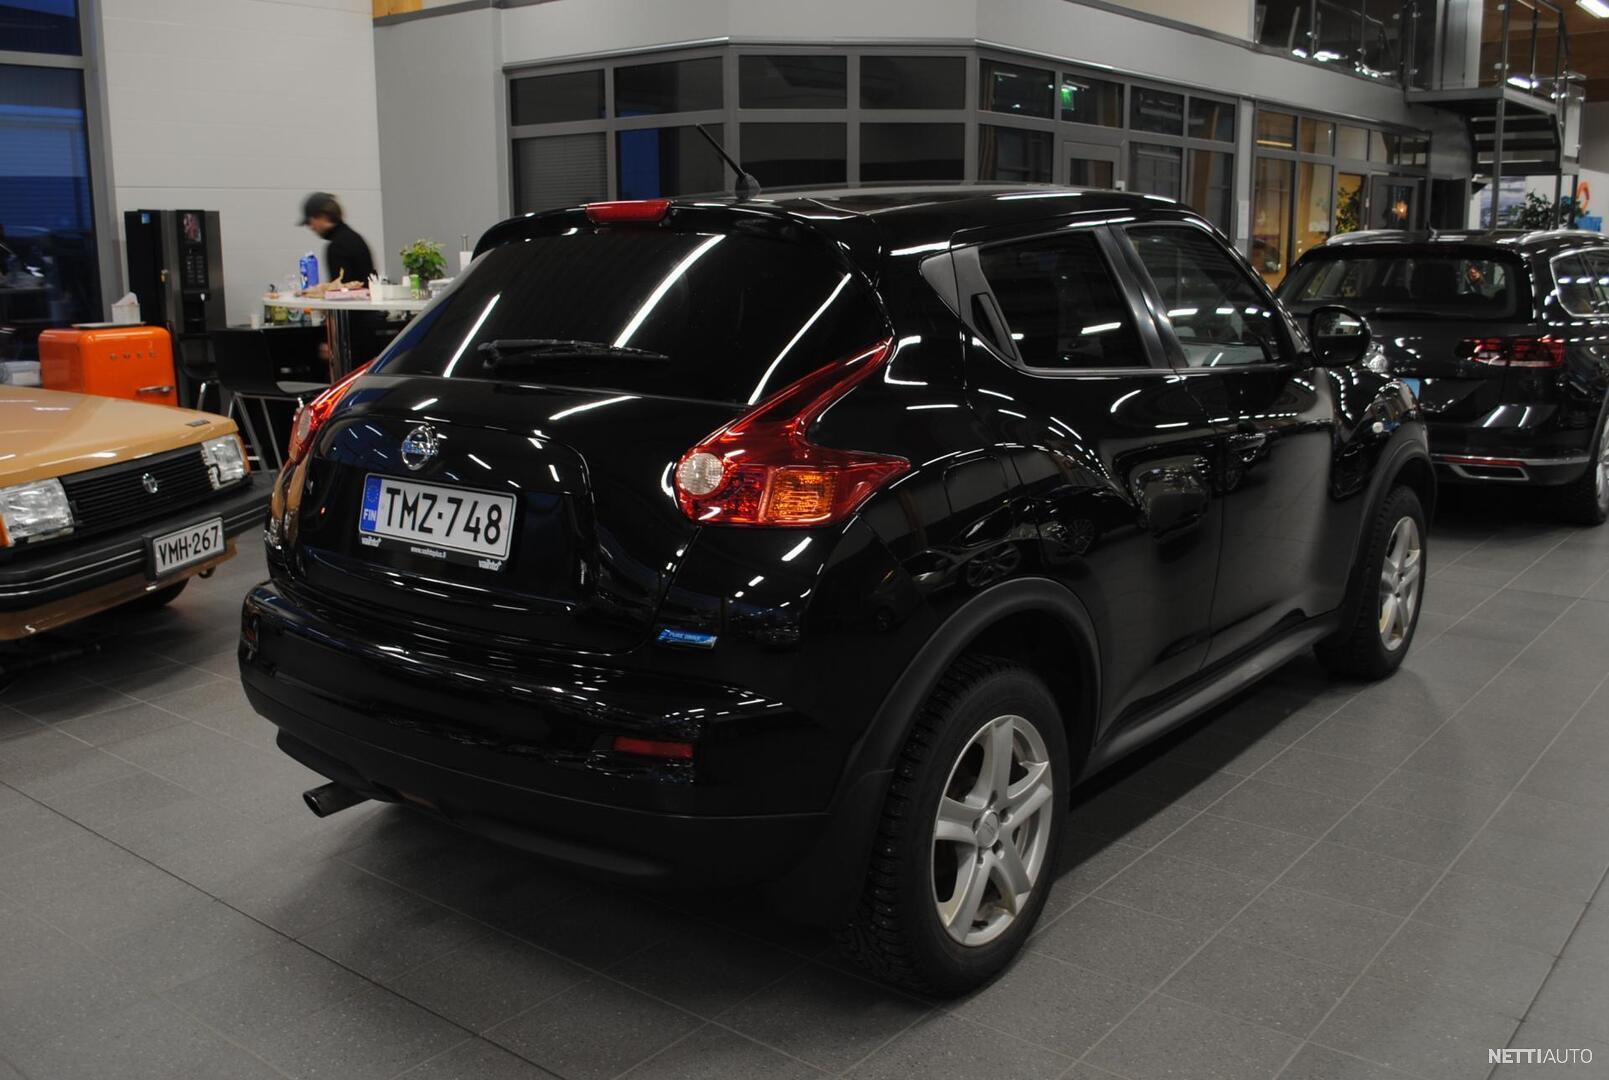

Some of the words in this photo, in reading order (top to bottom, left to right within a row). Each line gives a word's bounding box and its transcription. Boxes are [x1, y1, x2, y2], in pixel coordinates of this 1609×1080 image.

[362, 508, 377, 522] FIN
[386, 487, 503, 545] TMZ-748
[158, 525, 218, 566] VMH-267
